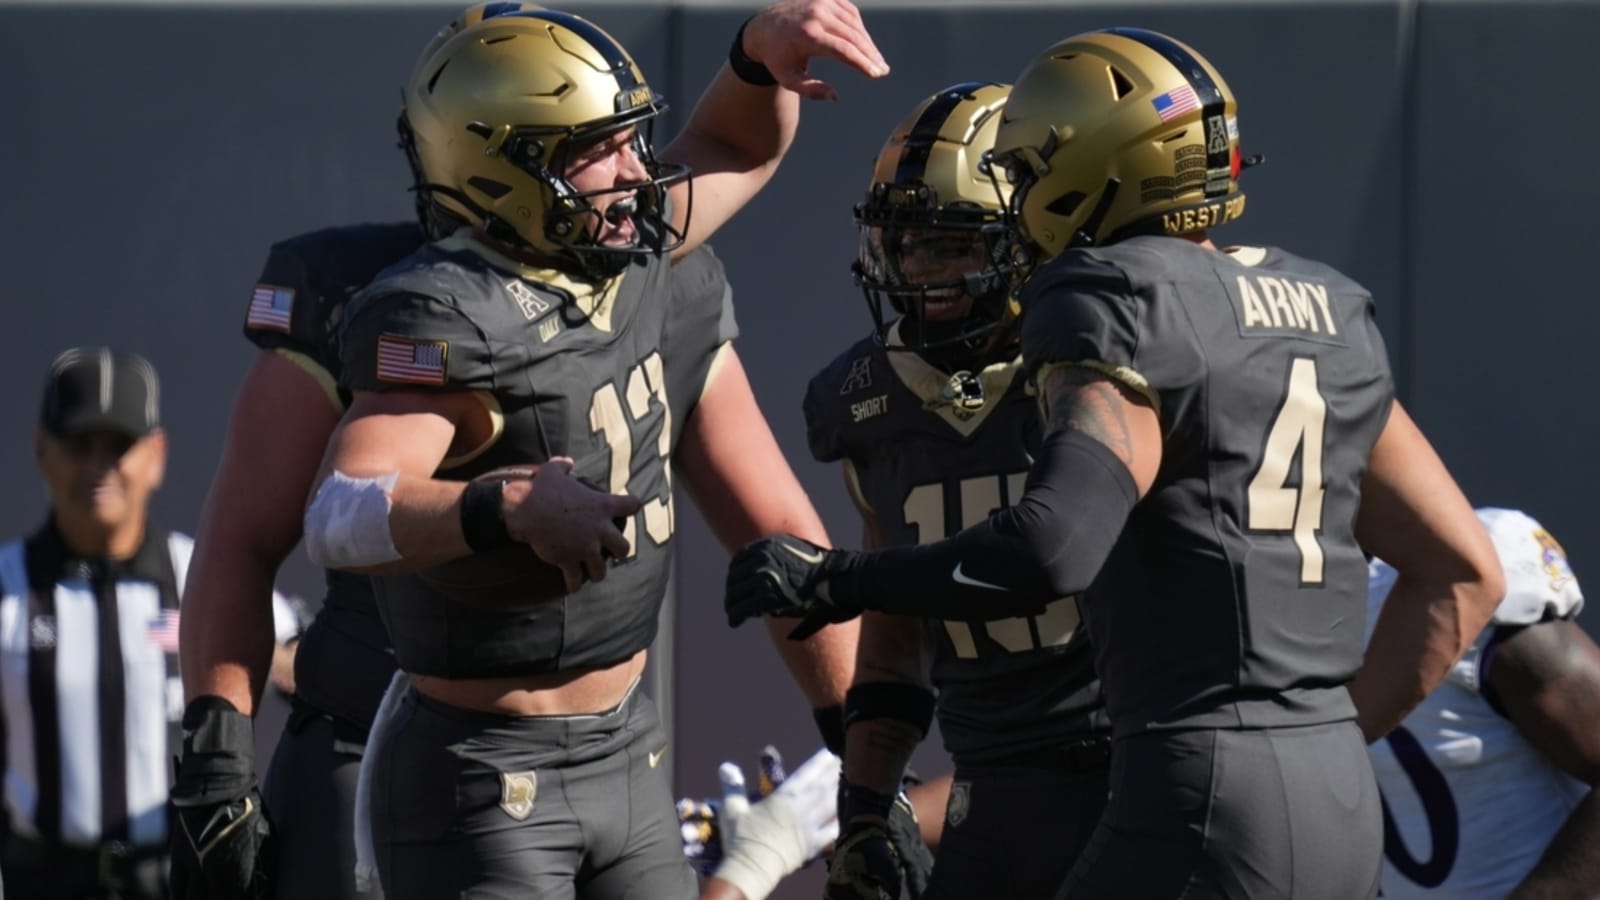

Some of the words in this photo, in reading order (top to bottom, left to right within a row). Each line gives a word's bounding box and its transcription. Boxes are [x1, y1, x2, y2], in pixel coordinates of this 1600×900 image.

[1162, 204, 1221, 233] WEST
[1237, 276, 1337, 335] ARMY
[850, 394, 889, 423] SHORT
[588, 350, 675, 561] 13
[1246, 356, 1328, 585] 4
